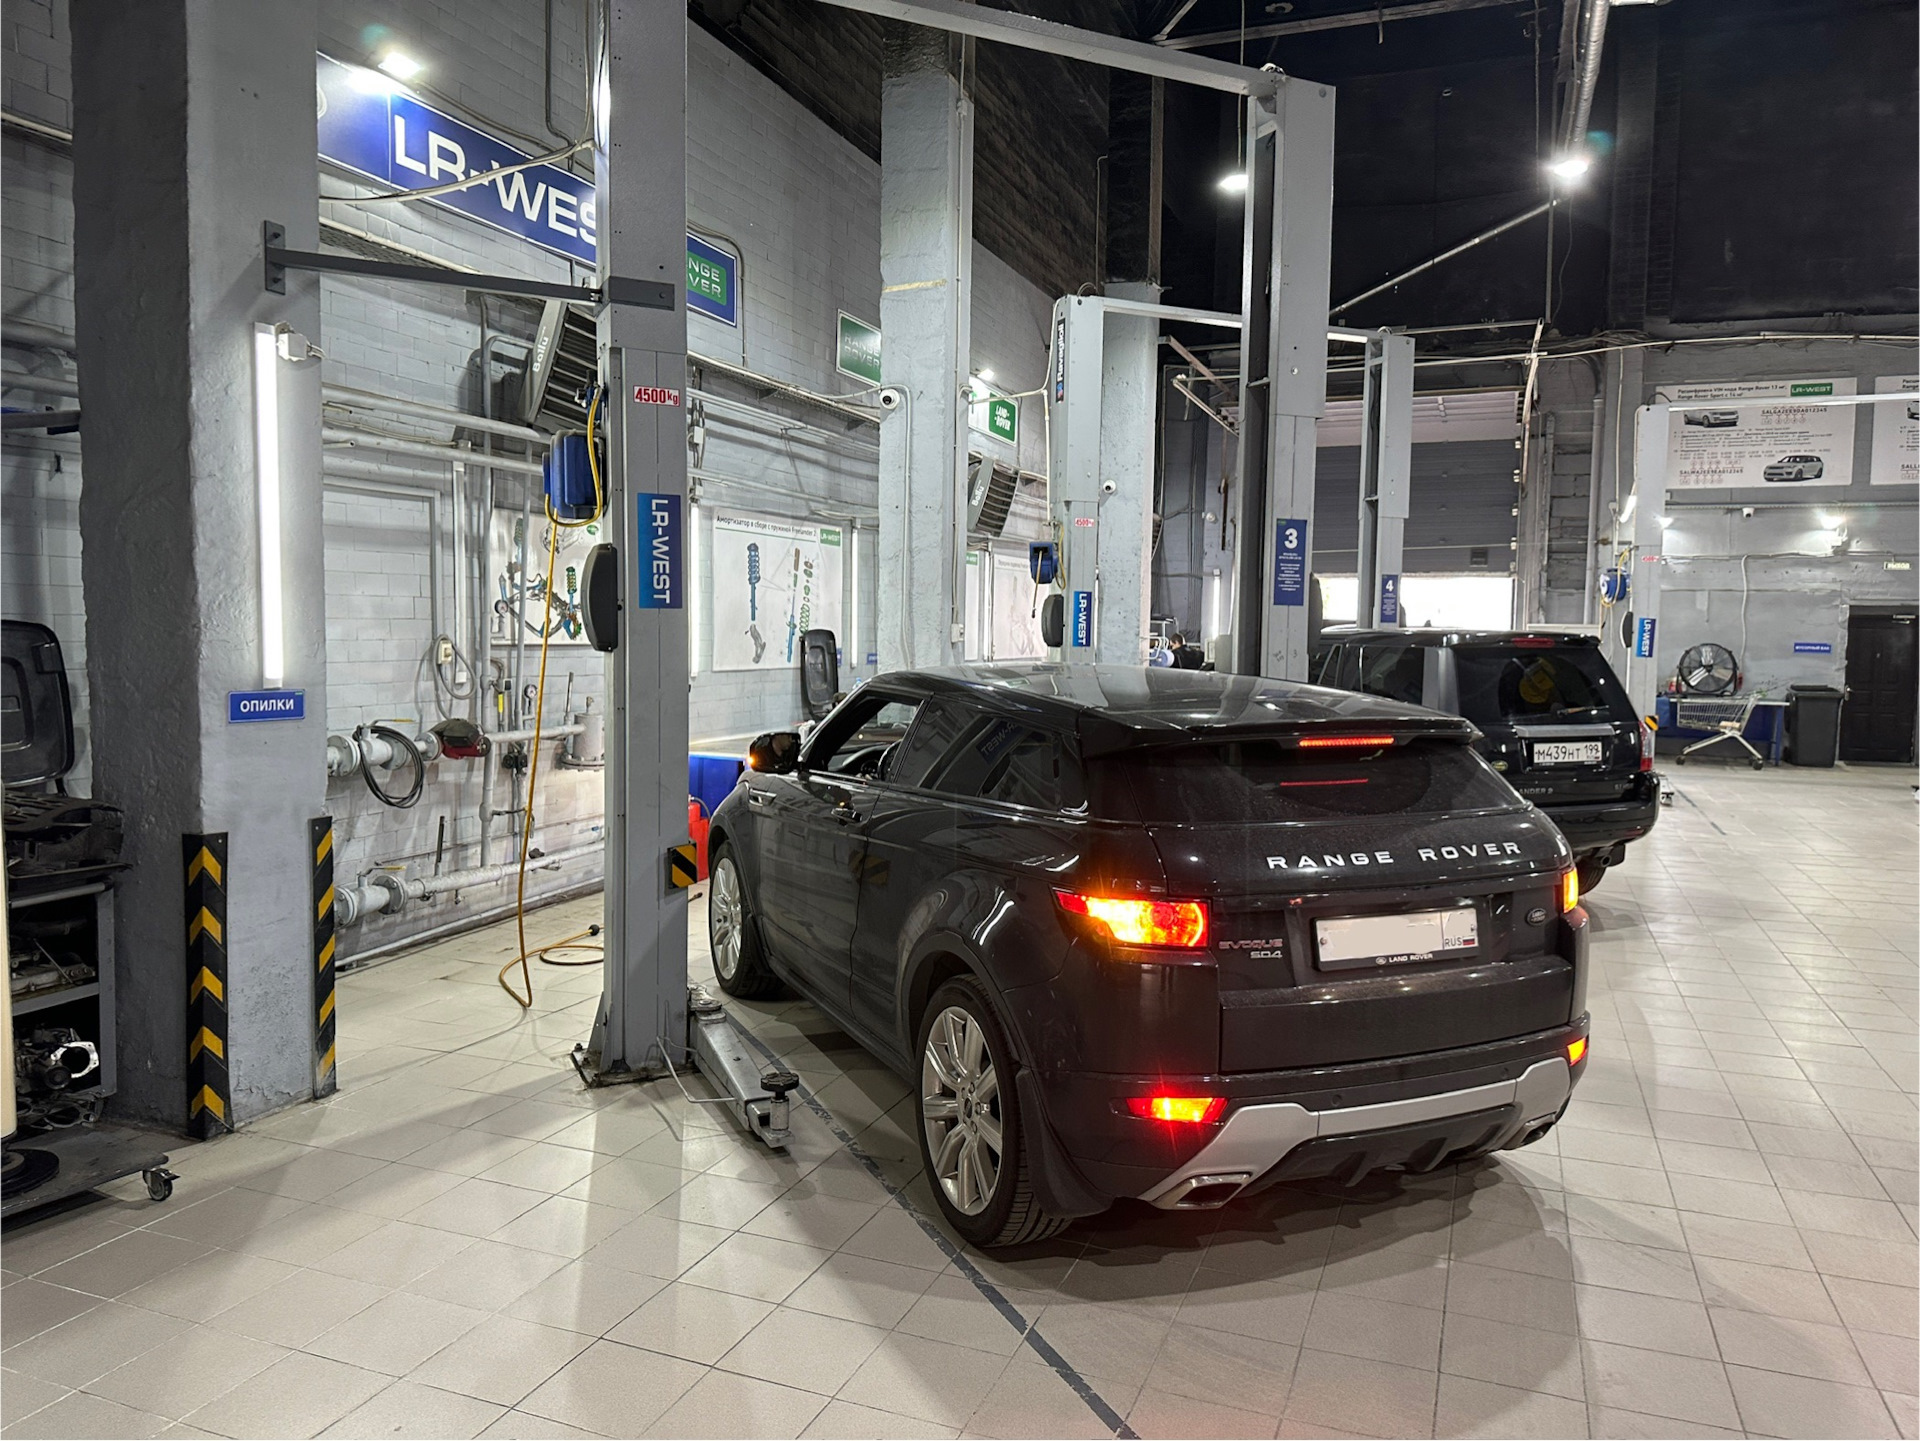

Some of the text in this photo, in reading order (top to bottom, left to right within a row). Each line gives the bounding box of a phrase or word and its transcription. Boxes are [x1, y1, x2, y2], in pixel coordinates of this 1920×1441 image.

[689, 257, 720, 283] NGE
[689, 273, 721, 298] VER
[532, 336, 549, 373] Ballu
[844, 334, 880, 357] RANGE
[716, 515, 750, 527] Амортизатор
[755, 522, 768, 530] сборе
[1284, 528, 1298, 549] 3
[651, 499, 670, 604] LR-WEST
[1385, 579, 1394, 592] 4
[1077, 594, 1087, 645] LR-WEST
[1641, 620, 1651, 656] LR-WEST
[240, 698, 295, 712] ОПИЛКИ
[1584, 743, 1600, 755] 199
[1266, 841, 1522, 869] RANGE ROVER
[1218, 938, 1283, 949] EVOQUE
[1444, 937, 1462, 947] RUS
[1250, 950, 1283, 959] SD4
[1388, 953, 1433, 963] LAND ROVER
